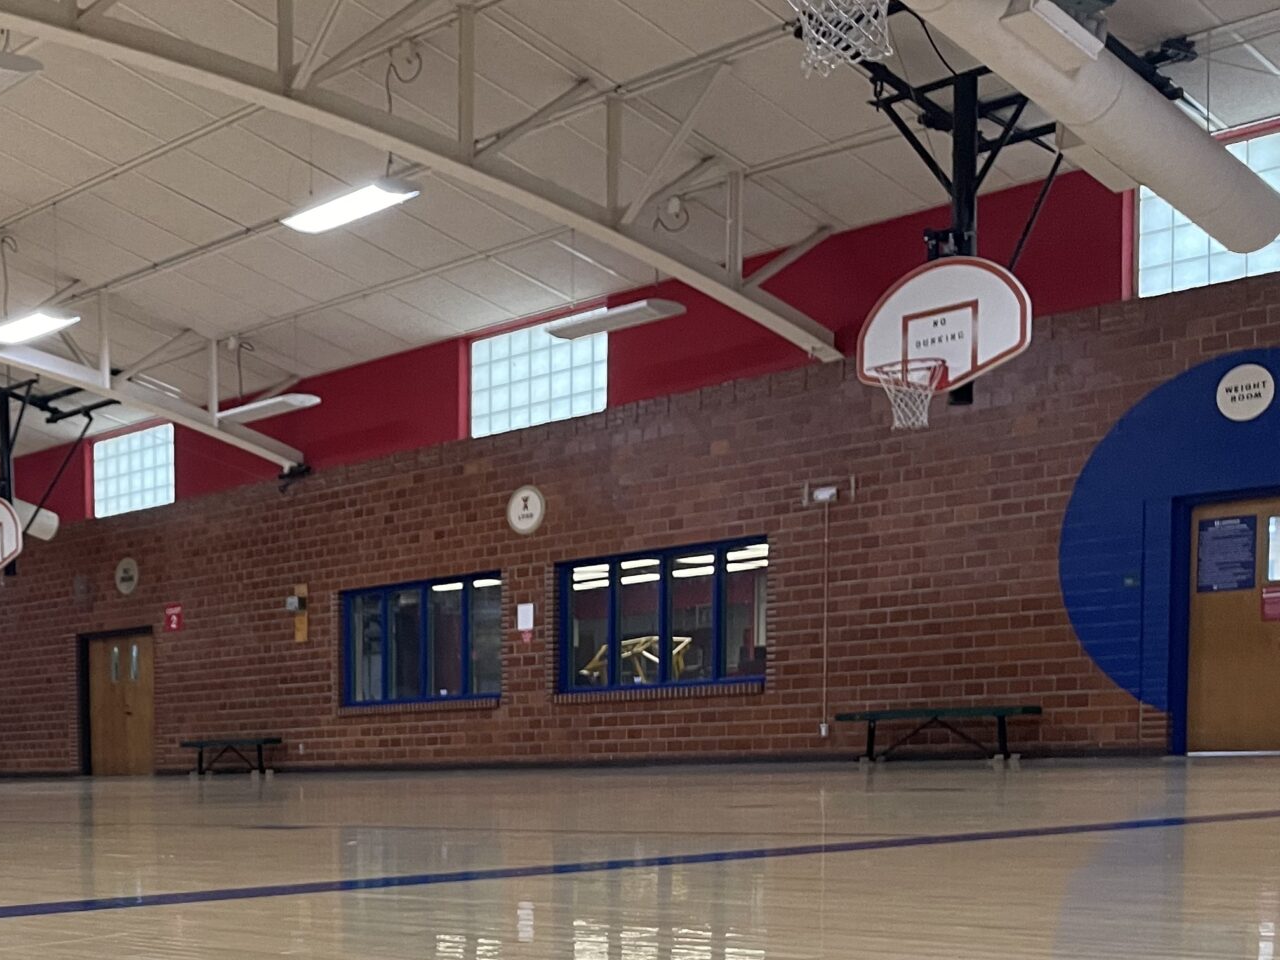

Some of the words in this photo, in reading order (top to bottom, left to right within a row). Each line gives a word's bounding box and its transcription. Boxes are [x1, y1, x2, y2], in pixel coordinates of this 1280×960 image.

[933, 318, 946, 327] NO
[915, 330, 964, 349] DUNKING
[1225, 380, 1267, 393] WEIGHT
[1231, 392, 1262, 402] ROOM
[170, 615, 178, 629] 2
